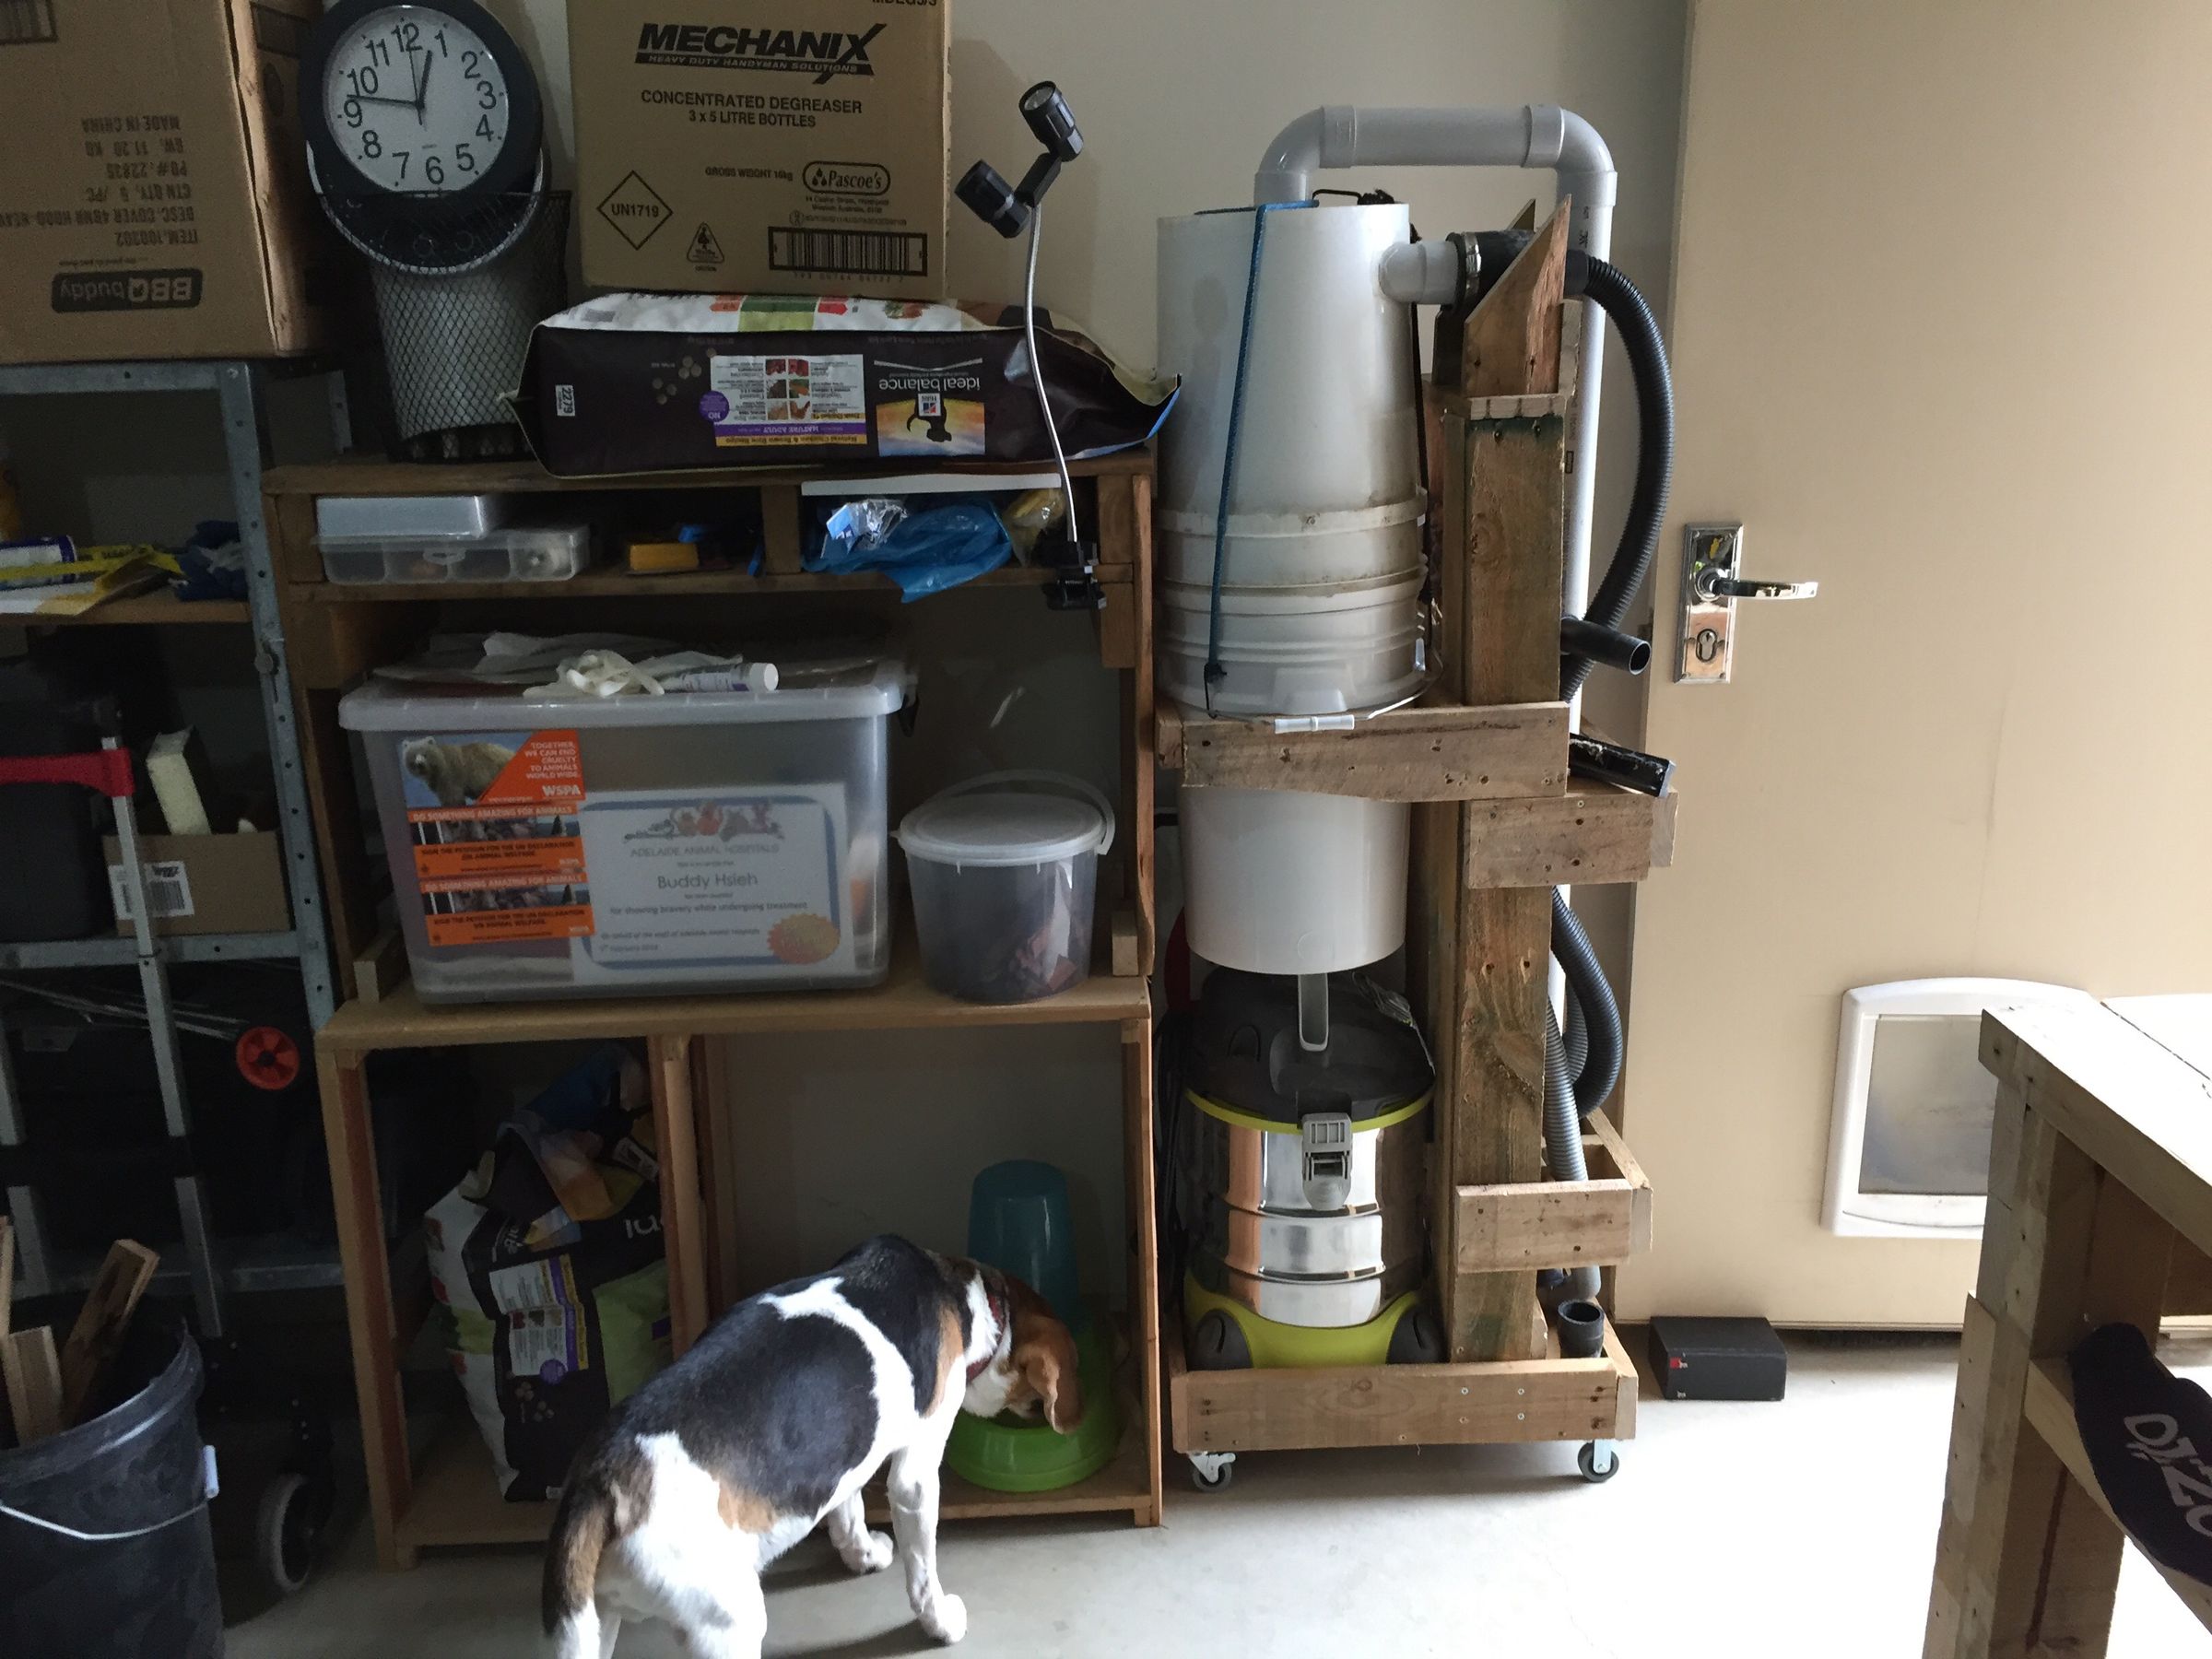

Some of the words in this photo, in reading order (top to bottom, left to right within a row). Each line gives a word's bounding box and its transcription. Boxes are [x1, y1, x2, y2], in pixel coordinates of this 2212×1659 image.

[391, 22, 423, 53] 12
[434, 29, 448, 58] 1
[365, 39, 390, 67] 11
[638, 23, 887, 84] MECHANIX
[461, 51, 480, 78] 2
[648, 55, 686, 65] HEAVY
[688, 56, 720, 66] DUTY
[723, 57, 787, 70] HANDYMAN
[792, 61, 857, 74] SOLUTIONS
[347, 66, 379, 97] 10
[477, 80, 497, 110] 3
[641, 89, 765, 109] CONCENTRATED
[769, 96, 863, 114] DEGREASER
[343, 99, 362, 128] 9
[688, 110, 696, 122] 3
[700, 112, 707, 123] x
[709, 111, 717, 123] 5
[720, 112, 756, 125] LITRE
[759, 113, 817, 128] BOTTLES
[81, 117, 123, 133] CHINA
[126, 116, 141, 132] IN
[146, 115, 180, 131] MADE
[476, 113, 494, 142] 4
[361, 129, 382, 159] 8
[392, 151, 410, 179] 7
[455, 143, 475, 171] 5
[425, 156, 444, 185] 6
[705, 166, 735, 178] GROSS
[737, 168, 772, 179] WEIGHT
[828, 170, 883, 190] Pascoe's
[166, 183, 192, 200] CTN
[113, 207, 156, 224] COVER
[611, 203, 660, 218] UN1719
[59, 280, 128, 300] buddy
[129, 276, 192, 301] BBQ
[878, 378, 940, 392] balance
[943, 376, 981, 391] ideal
[561, 387, 574, 414] 2279
[763, 426, 787, 434] ADULT
[788, 425, 819, 433] MATURE
[541, 756, 576, 764] CRUELTY
[541, 784, 582, 796] WSPA
[428, 809, 475, 820] SOMETHING
[477, 808, 516, 818] AMAZING
[518, 807, 534, 816] FOR
[535, 806, 572, 815] ANIMALS
[630, 846, 680, 857] ADELAIDE
[684, 845, 721, 855] ANIMAL
[724, 843, 780, 854] HOSPITALS
[488, 877, 526, 888] AMAZING
[657, 873, 710, 889] Buddy
[714, 871, 759, 887] Hsieh
[660, 904, 691, 914] bravery
[719, 902, 764, 912] undergoing
[767, 900, 807, 911] treatment
